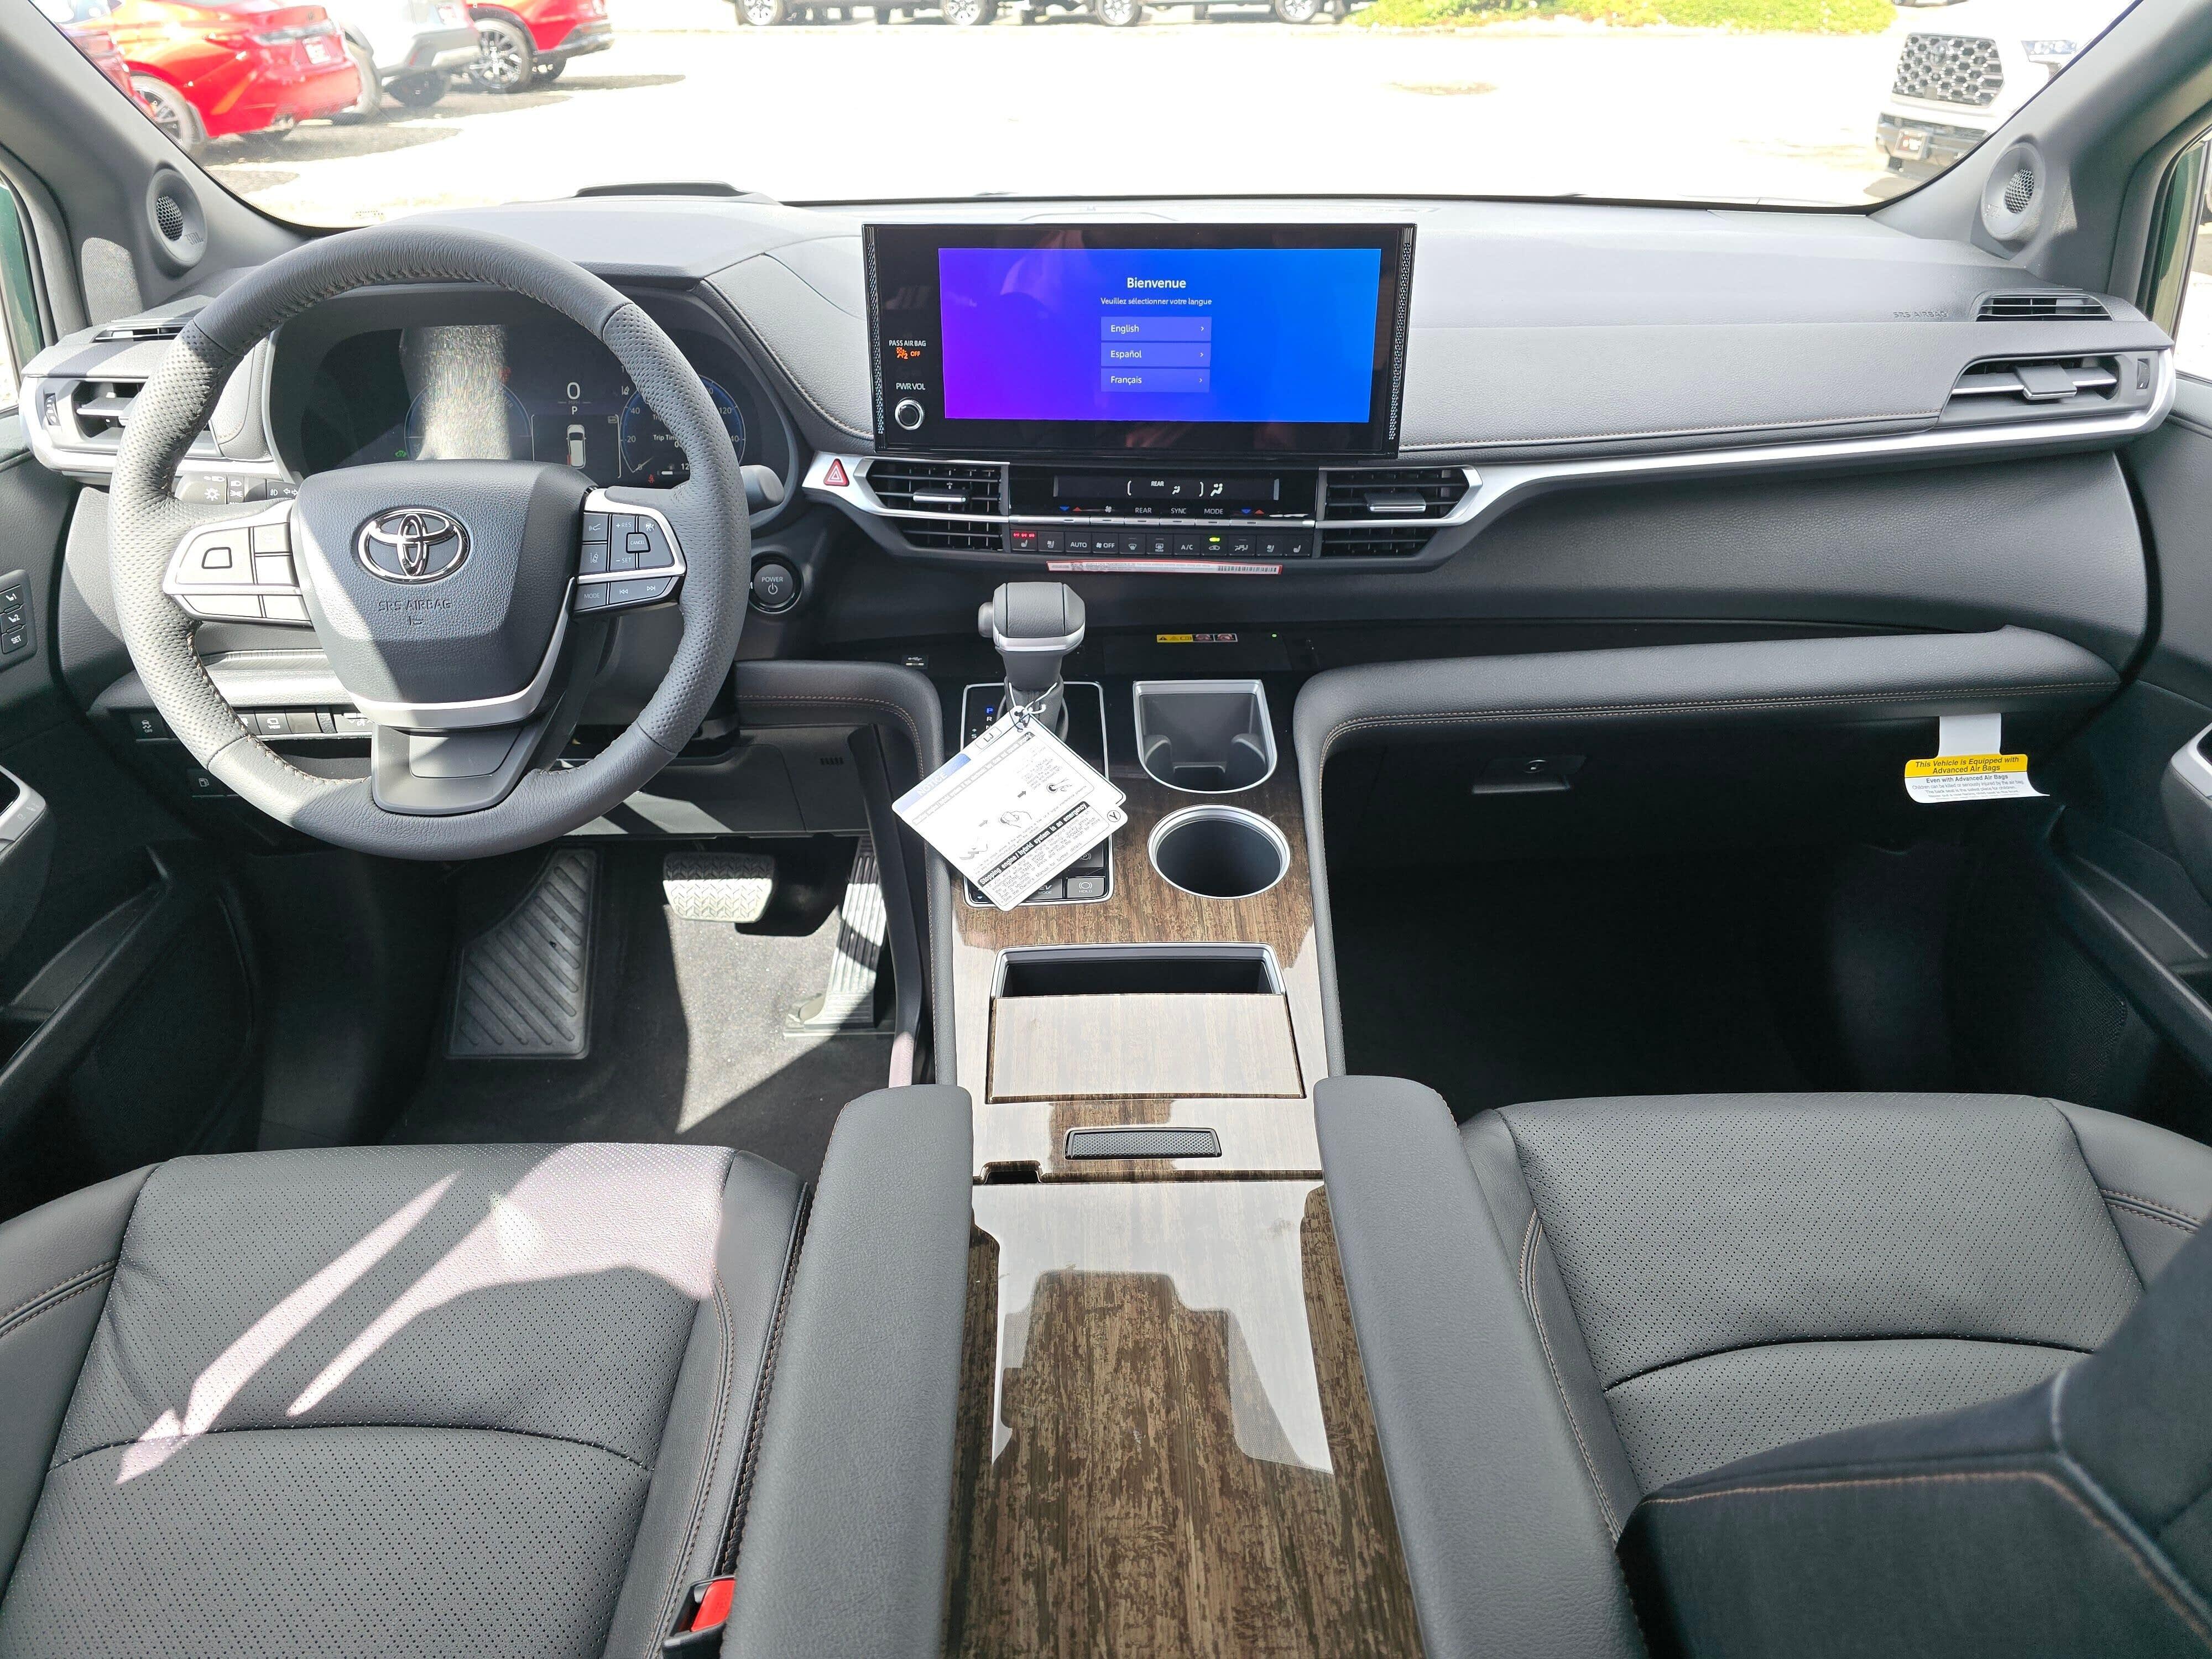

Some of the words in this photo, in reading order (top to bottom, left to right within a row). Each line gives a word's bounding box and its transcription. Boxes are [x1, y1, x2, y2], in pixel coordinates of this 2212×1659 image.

[1126, 277, 1186, 288] Bienvenue
[1188, 298, 1212, 307] langue
[1110, 325, 1139, 334] English
[1110, 350, 1142, 359] Español
[1110, 375, 1142, 385] Français
[567, 382, 581, 400] 0
[572, 406, 578, 415] P
[378, 601, 401, 611] SRS
[405, 599, 452, 611] AIRBAG
[11, 635, 22, 644] SET
[983, 733, 994, 742] LJ
[1969, 757, 2002, 766] Equipped
[1933, 765, 1968, 774] Advanced
[1983, 764, 2000, 773] Bags
[916, 771, 948, 797] NOTICE
[1109, 810, 1118, 820] Y
[979, 866, 1001, 885] Stopping
[1017, 841, 1035, 857] hybrid
[1032, 829, 1051, 845] system
[1062, 802, 1087, 823] emergency
